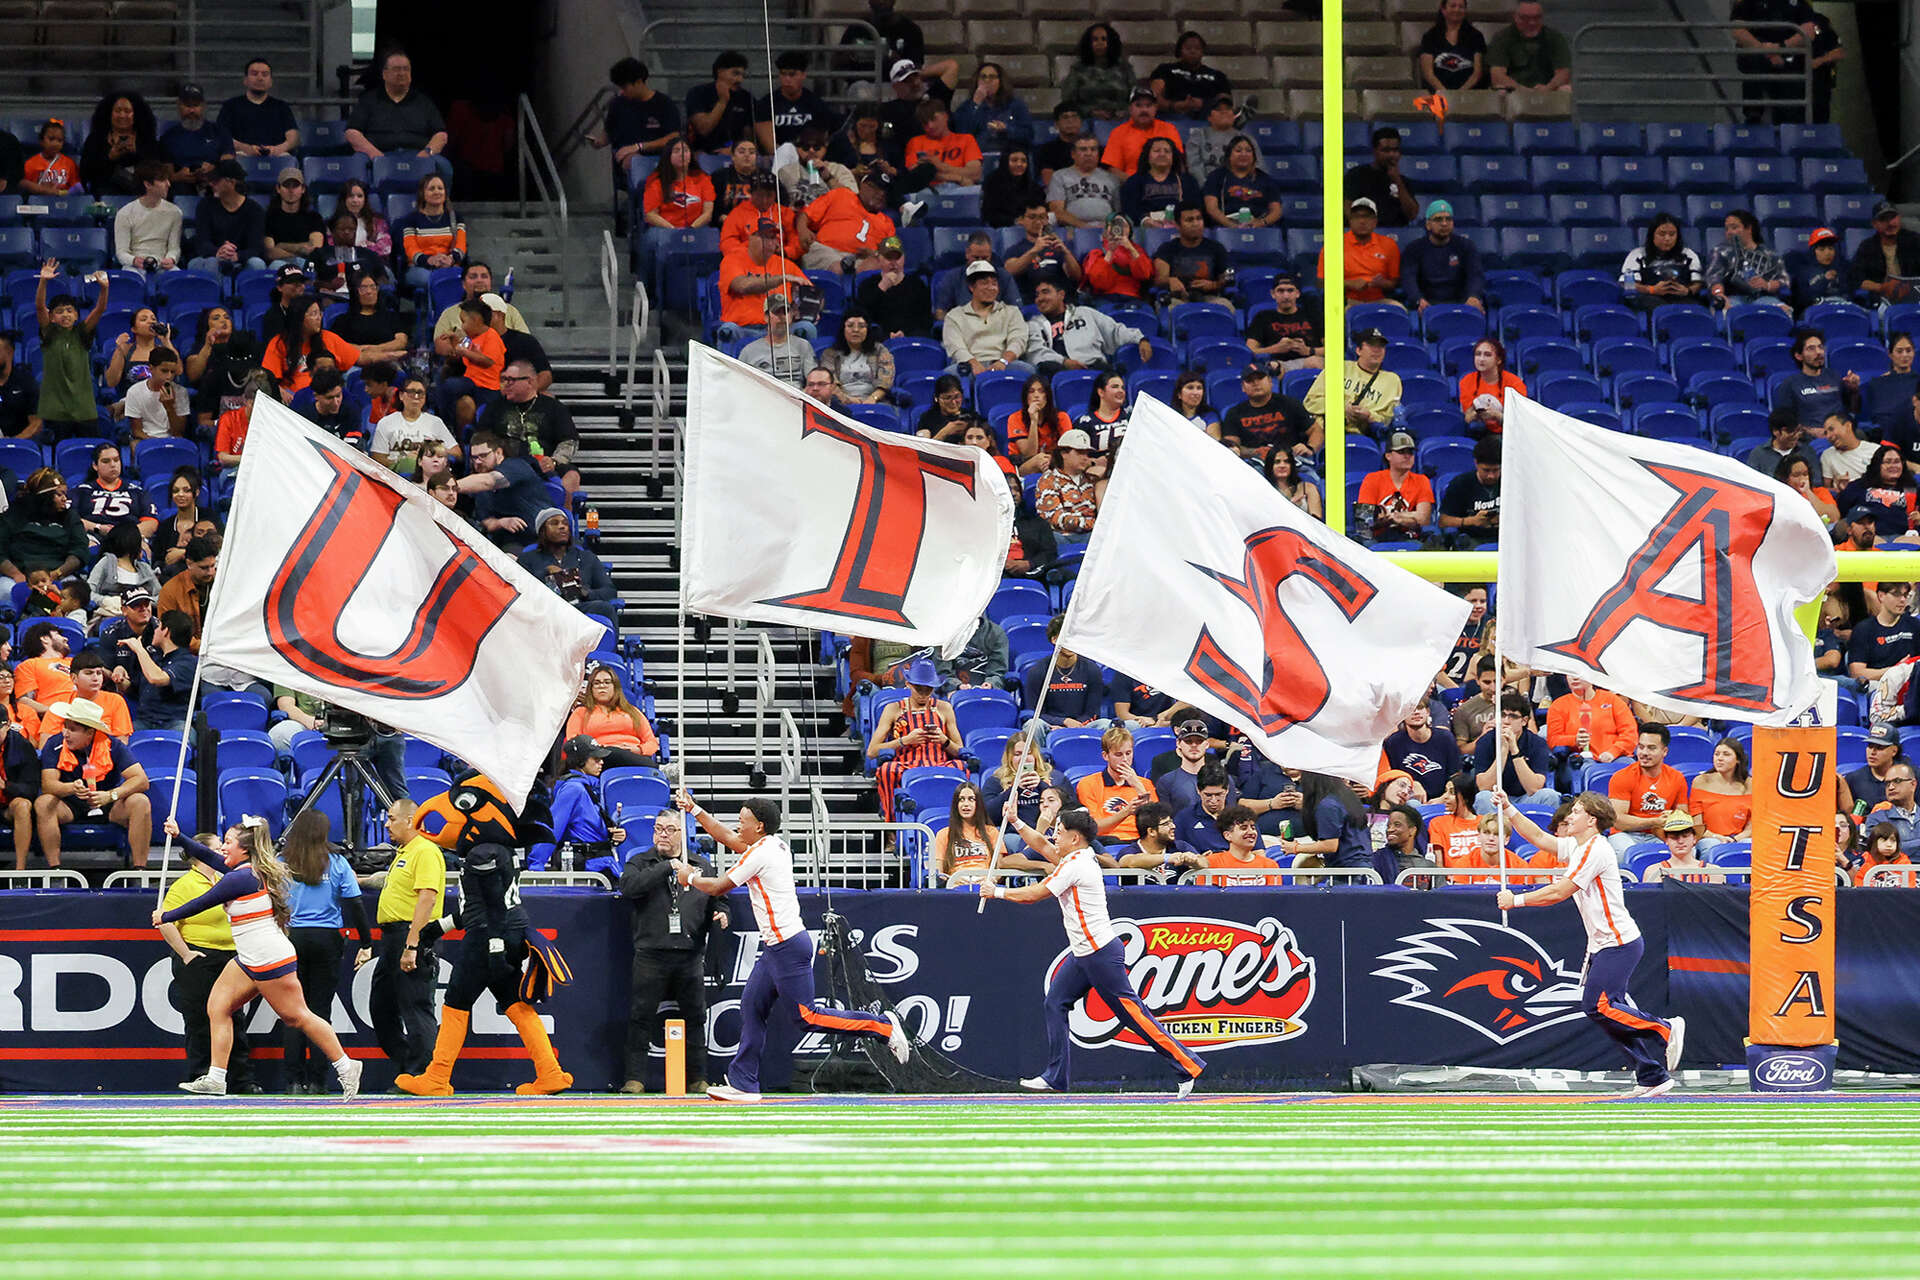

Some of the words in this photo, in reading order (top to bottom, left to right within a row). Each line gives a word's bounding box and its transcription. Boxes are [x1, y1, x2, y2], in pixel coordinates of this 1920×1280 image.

[775, 113, 812, 126] UTSA
[856, 218, 870, 243] 1
[1240, 411, 1285, 428] UTSA
[92, 489, 131, 498] UTSA
[91, 497, 133, 517] 15
[752, 399, 976, 630] T
[264, 437, 521, 699] U
[1536, 456, 1793, 712] A
[1184, 526, 1379, 737] S
[955, 846, 987, 858] UTSA
[1150, 927, 1235, 950] Raising
[1765, 1058, 1816, 1082] Ford
